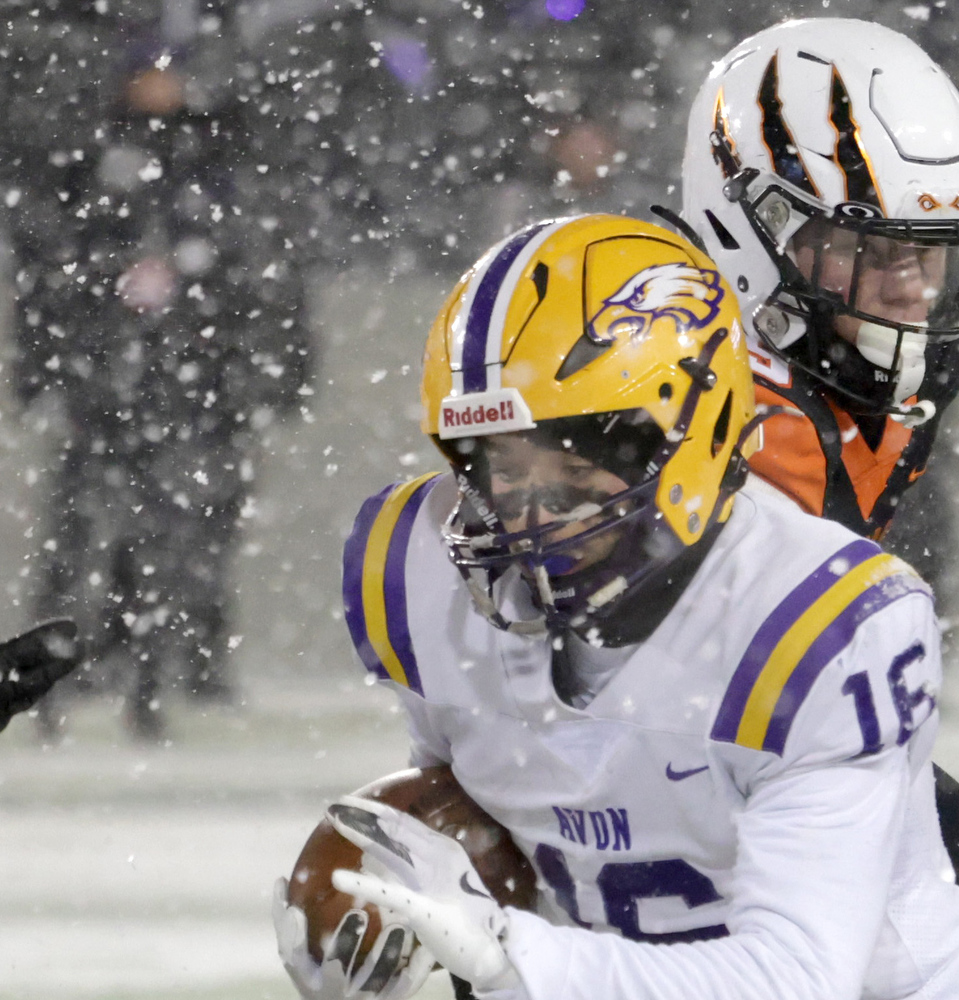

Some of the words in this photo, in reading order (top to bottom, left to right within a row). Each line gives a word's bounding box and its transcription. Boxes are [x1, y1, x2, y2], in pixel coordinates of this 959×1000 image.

[443, 400, 515, 428] Riddell
[841, 638, 936, 758] 16
[551, 805, 632, 851] AVON
